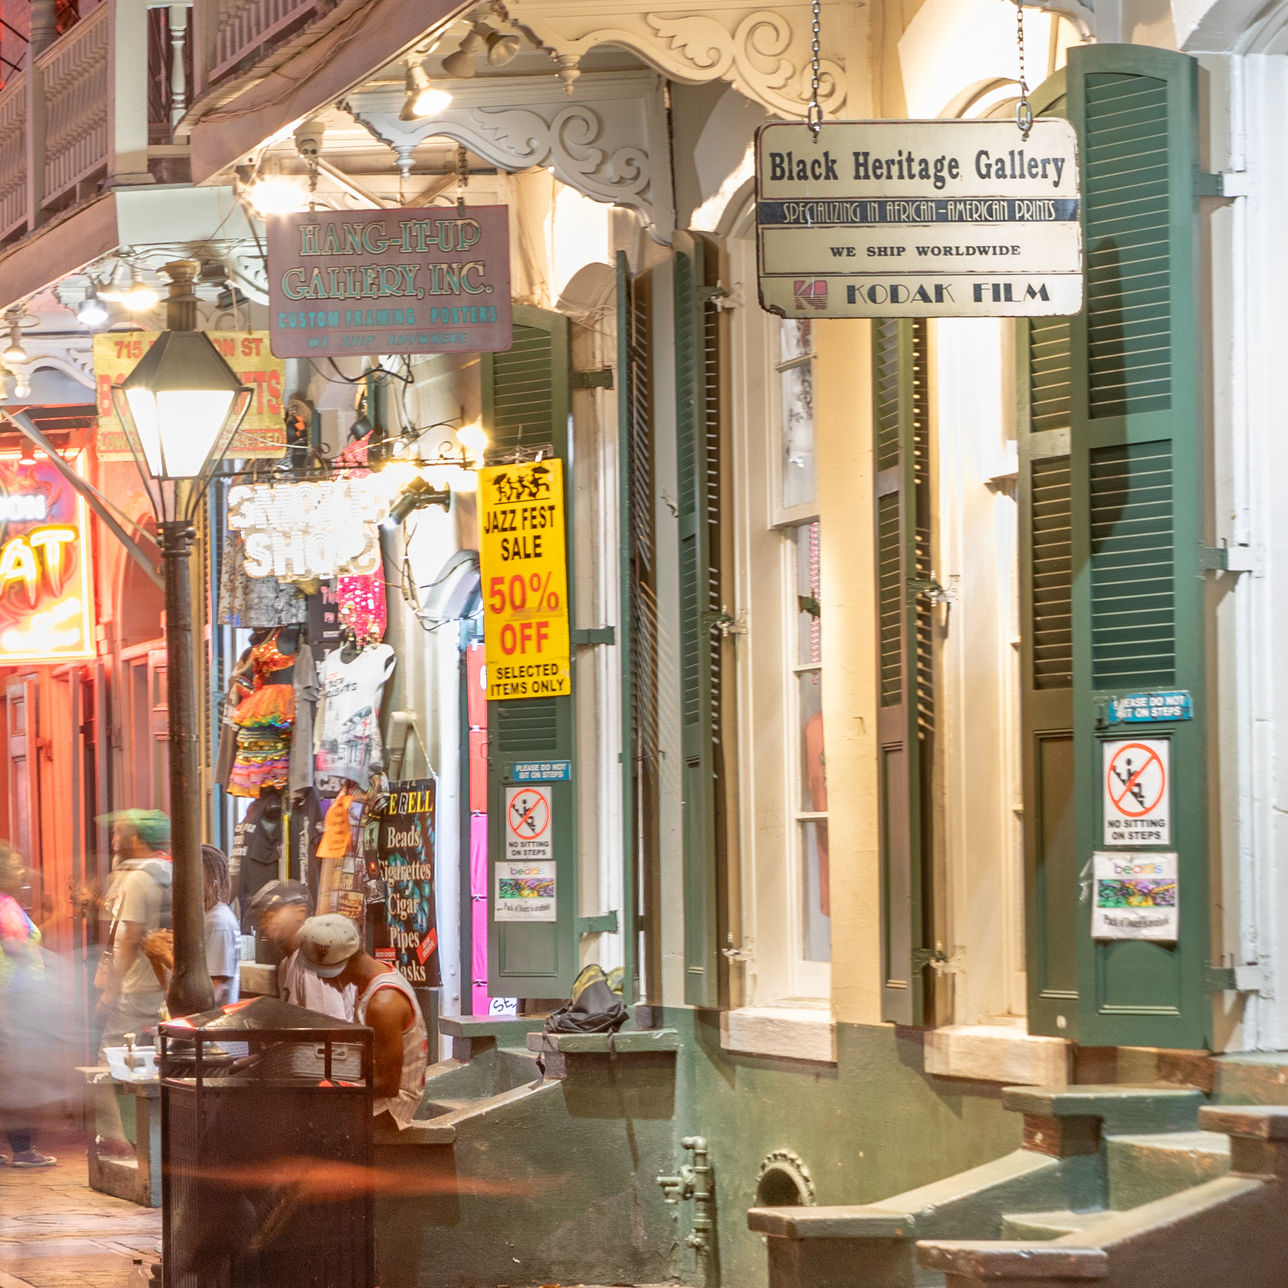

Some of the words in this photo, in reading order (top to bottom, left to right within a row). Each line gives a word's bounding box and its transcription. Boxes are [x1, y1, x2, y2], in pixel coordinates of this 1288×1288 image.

[769, 151, 838, 181] Black
[852, 150, 960, 190] Heritage
[975, 149, 1066, 188] Gallery
[783, 202, 859, 223] SPECIALIZING
[867, 203, 879, 222] IN
[1015, 200, 1056, 220] PRINTS
[299, 218, 482, 256] HANG-IT-UP
[830, 246, 856, 257] WE
[866, 246, 906, 257] SHIP
[915, 245, 1021, 256] WORLDWIDE
[281, 264, 424, 300] GALLERY,
[429, 260, 493, 295] INC.
[846, 283, 955, 304] KODAK
[972, 282, 1050, 303] FILM
[278, 310, 339, 328] CUSTOM
[345, 308, 415, 327] FRAMING
[430, 305, 498, 324] POSTERS
[115, 341, 143, 358] 715
[241, 338, 263, 357] ST
[308, 336, 330, 348] WE
[340, 335, 374, 347] SHIP
[386, 332, 468, 346] ANYWHERE
[484, 509, 517, 534] JAZZ
[522, 505, 556, 530] FEST
[244, 530, 368, 576] SHOP
[501, 535, 543, 561] SALE
[489, 571, 559, 615] 50%
[501, 621, 549, 655] OFF
[496, 664, 559, 679] SELECTED
[491, 681, 528, 696] ITEMS
[532, 679, 565, 694] ONLY
[1113, 697, 1148, 710] EASE
[1149, 696, 1163, 707] DO
[1165, 695, 1186, 706] NOT
[1134, 708, 1150, 718] ON
[1151, 706, 1182, 717] STEPS
[516, 764, 539, 772] PLEASE
[541, 763, 551, 771] DO
[552, 763, 567, 771] NOT
[542, 771, 564, 779] STEPS
[1107, 820, 1121, 828] NO
[1123, 819, 1165, 828] SITTING
[1111, 831, 1125, 840] ON
[1128, 831, 1161, 840] STEPS
[510, 867, 544, 875] beads
[1114, 863, 1163, 874] beads
[388, 893, 419, 920] Cigar
[389, 927, 420, 954] Pipes
